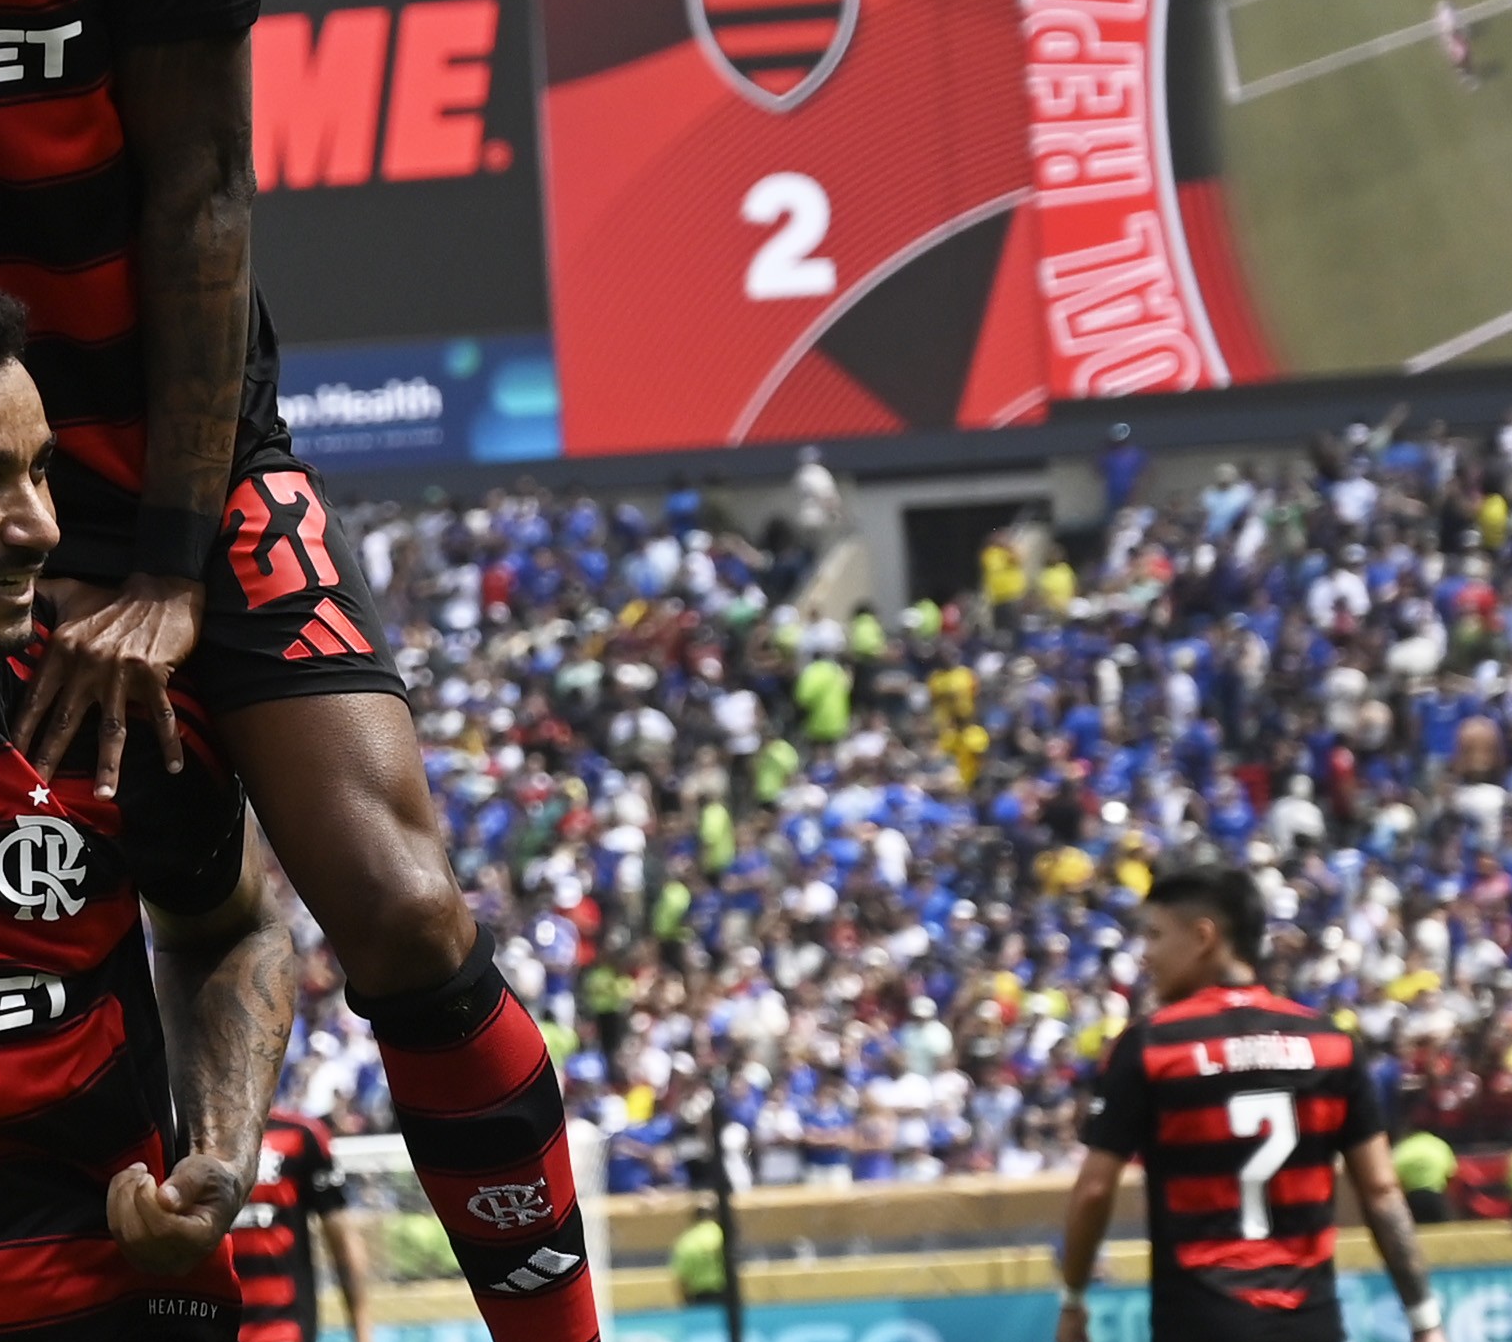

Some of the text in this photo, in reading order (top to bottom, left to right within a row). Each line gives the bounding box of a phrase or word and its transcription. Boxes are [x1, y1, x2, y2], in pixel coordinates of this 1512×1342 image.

[739, 168, 837, 302] 2
[1229, 1089, 1299, 1240] 7
[148, 1298, 219, 1320] HEAT.RDY
